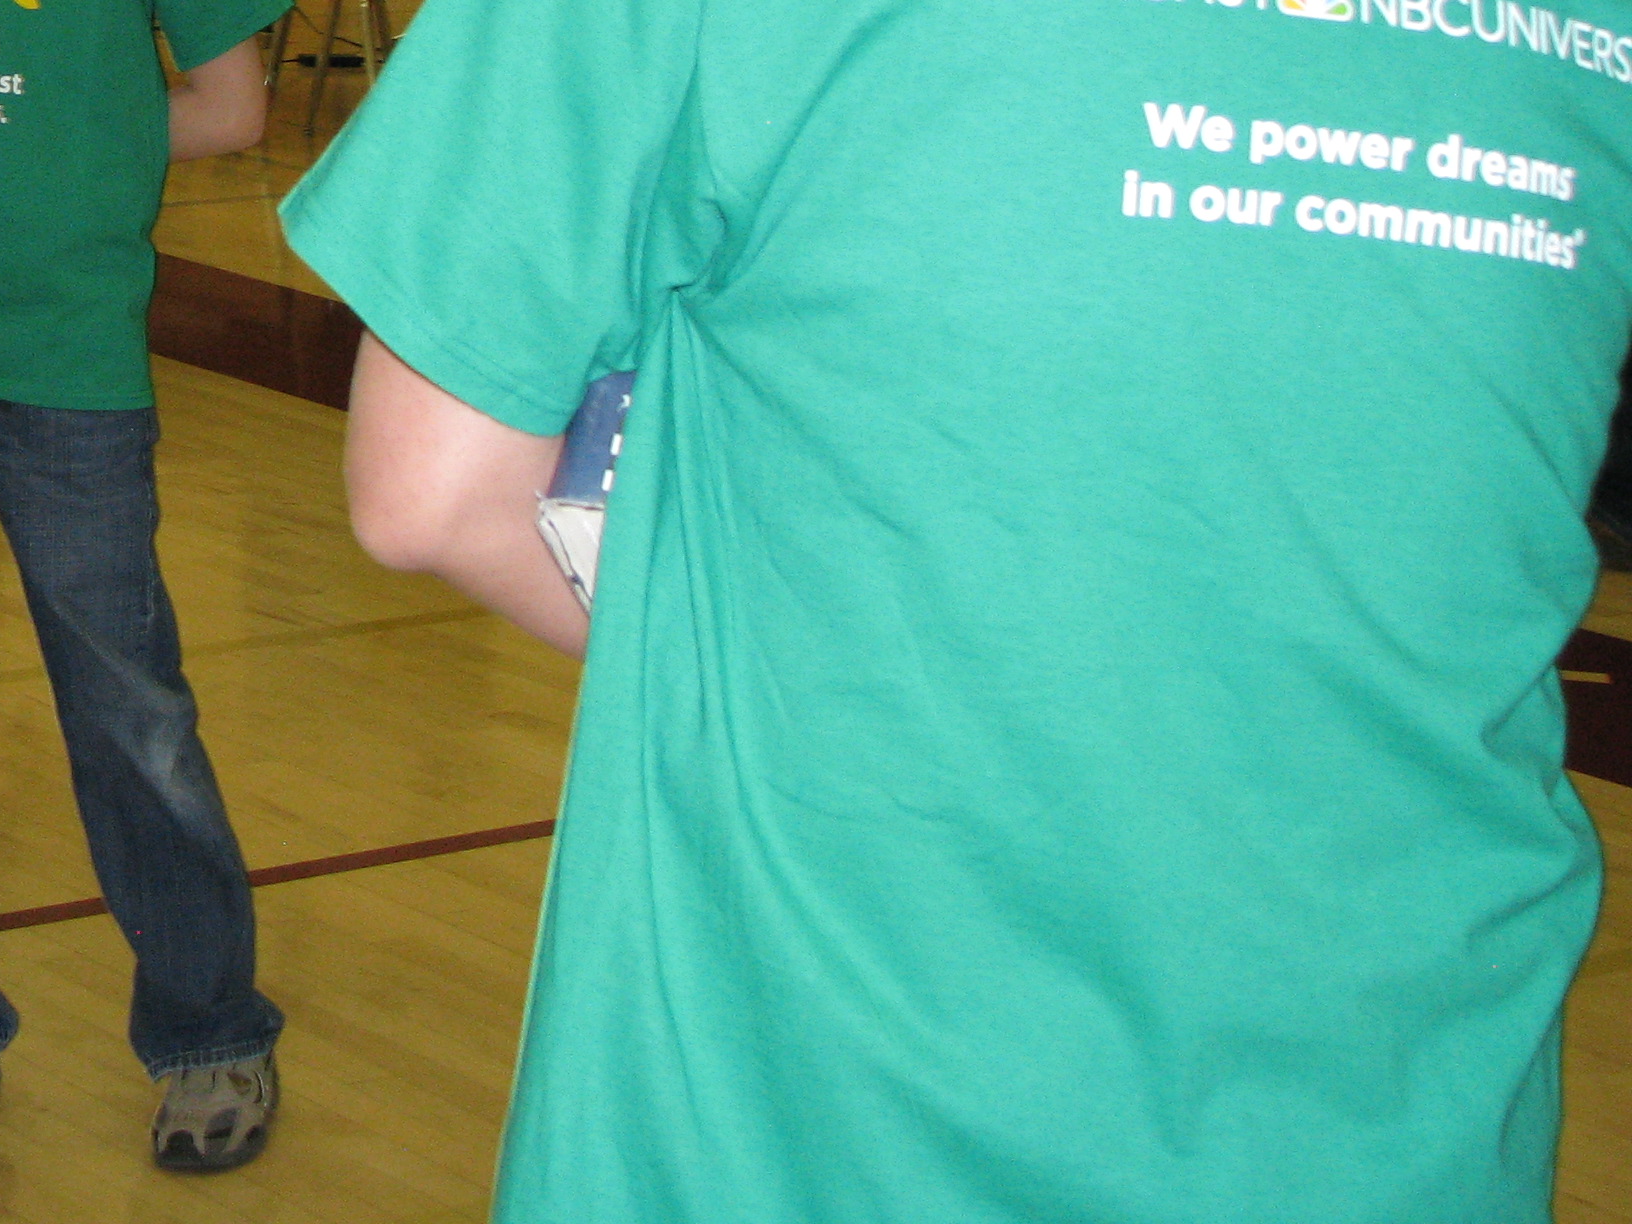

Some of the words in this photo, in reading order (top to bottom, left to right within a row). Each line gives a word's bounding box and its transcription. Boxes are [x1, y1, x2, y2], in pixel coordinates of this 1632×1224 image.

[1143, 102, 1236, 152] We
[1249, 119, 1414, 172] power
[1426, 133, 1576, 201] dreams
[1121, 168, 1174, 218] in
[1188, 184, 1283, 227] our
